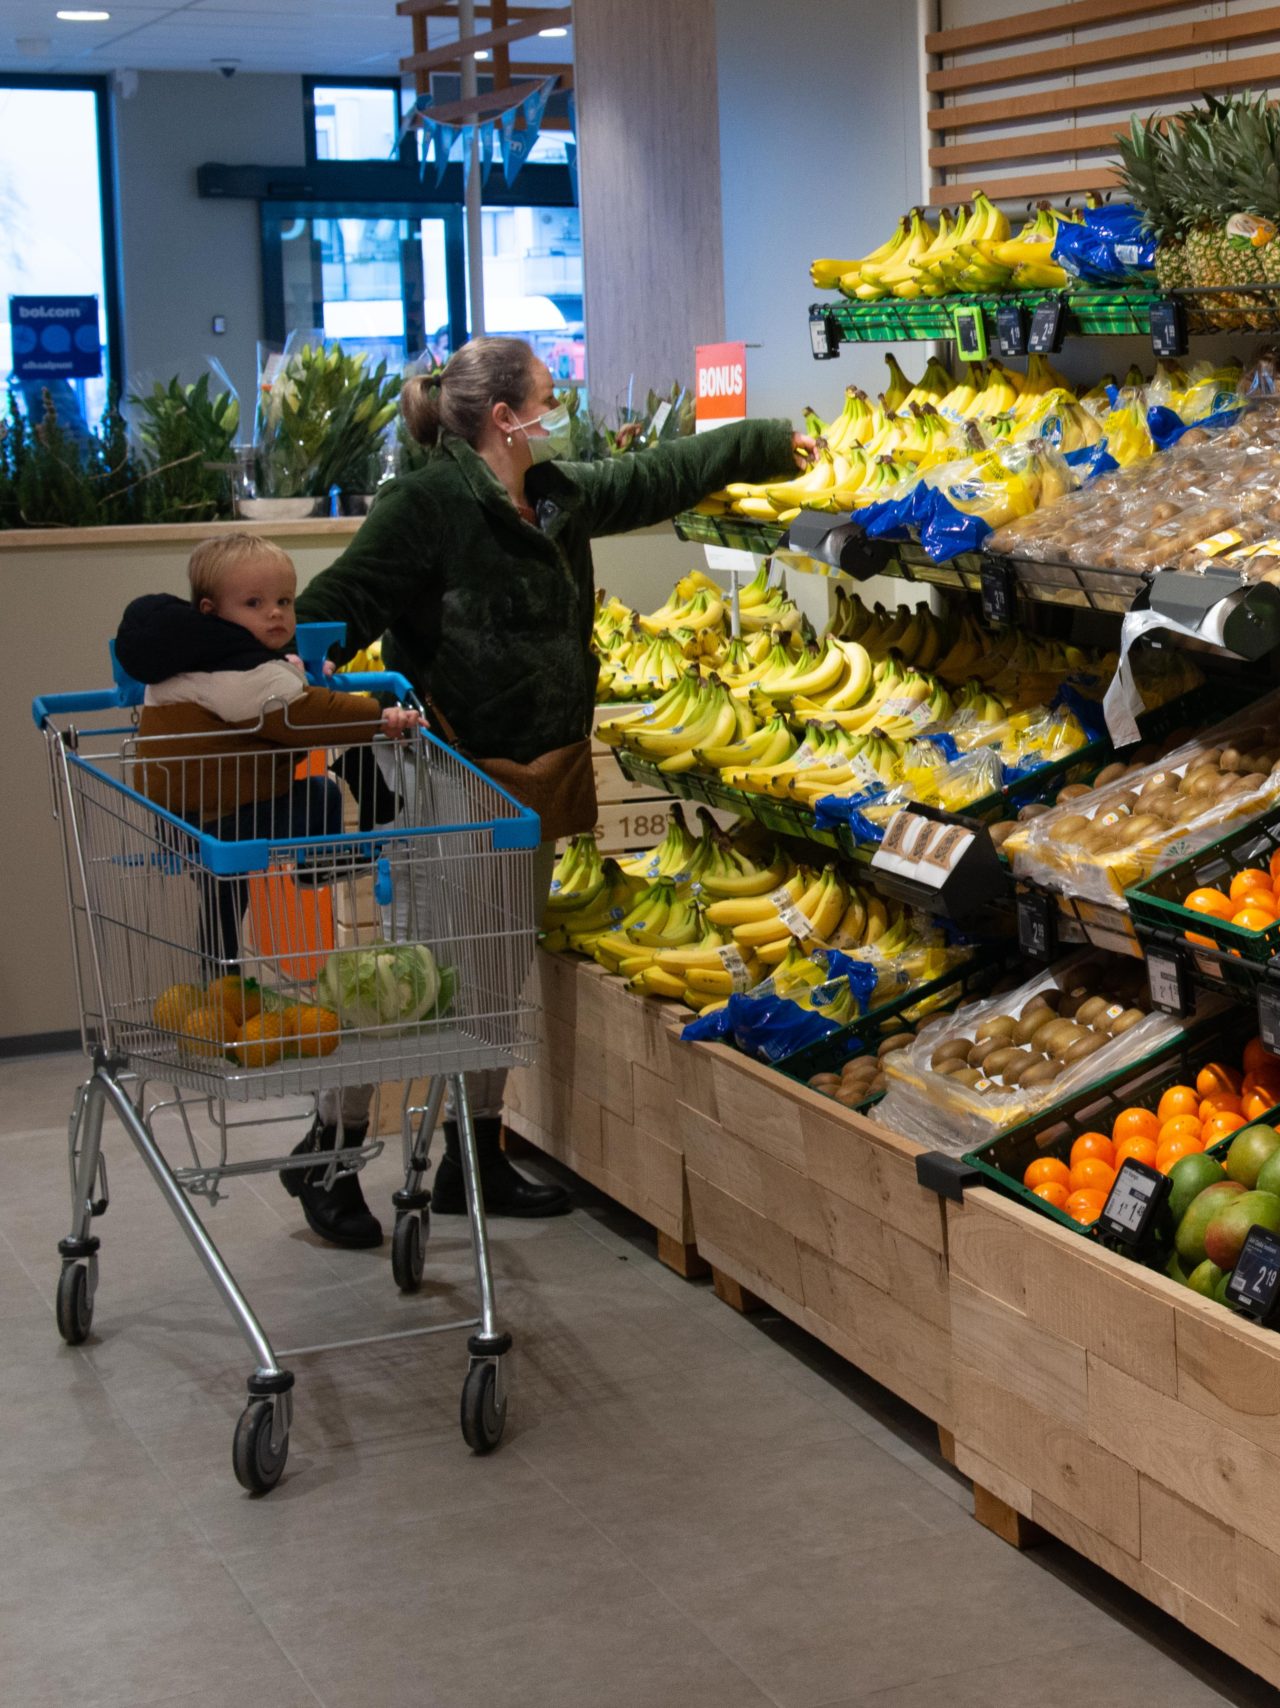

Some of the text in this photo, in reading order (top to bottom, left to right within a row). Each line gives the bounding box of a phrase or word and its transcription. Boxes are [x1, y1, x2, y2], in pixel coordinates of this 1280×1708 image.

[19, 306, 81, 318] bol.com
[699, 363, 742, 398] BONUS
[619, 811, 672, 838] 188
[1252, 1265, 1278, 1293] 2.19
